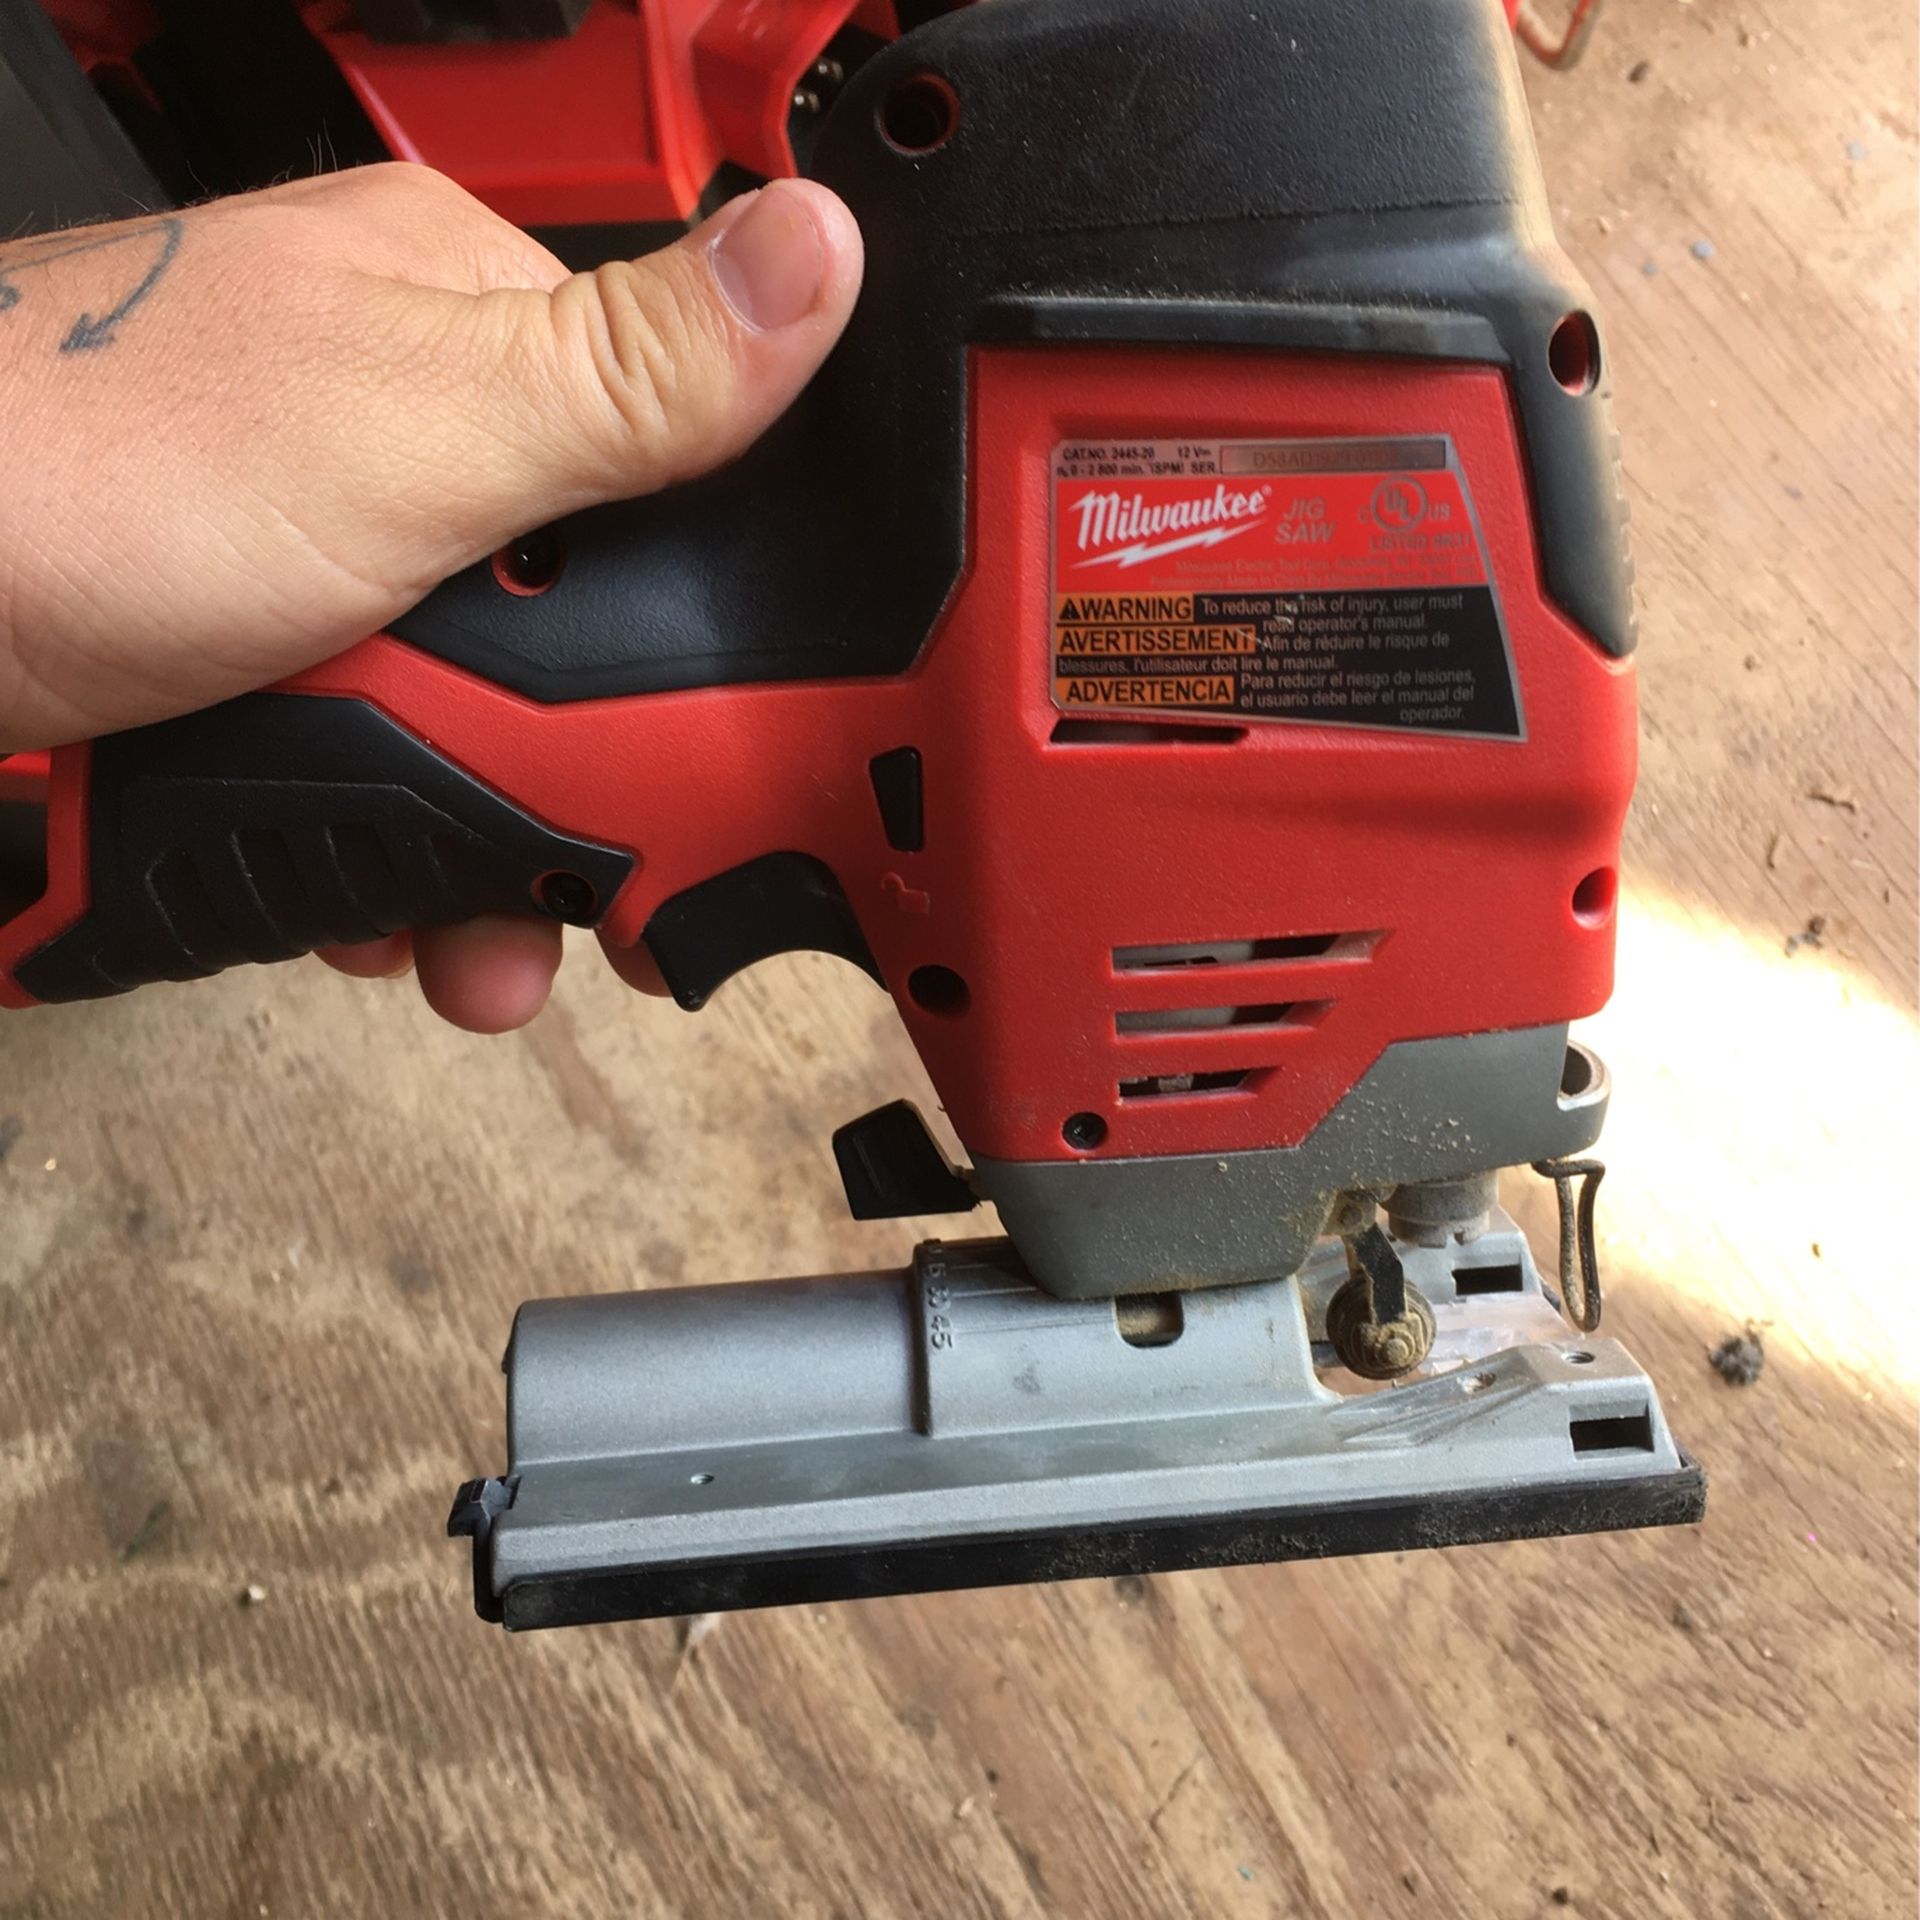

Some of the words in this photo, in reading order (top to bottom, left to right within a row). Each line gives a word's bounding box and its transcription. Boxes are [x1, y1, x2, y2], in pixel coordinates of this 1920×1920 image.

[1178, 446, 1189, 458] 12
[1068, 484, 1267, 552] Milwaukee
[1283, 498, 1327, 522] JIG
[1275, 522, 1337, 545] SAW
[1368, 535, 1428, 551] LISTED
[1080, 597, 1192, 620] WARNING
[1203, 599, 1218, 614] To
[1222, 599, 1271, 615] reduce
[1300, 597, 1327, 612] risk
[1331, 596, 1345, 612] of
[1349, 596, 1390, 615] injury,
[1394, 599, 1424, 611] user
[1429, 594, 1463, 609] must
[1299, 616, 1369, 637] operator's
[1373, 614, 1427, 630] manual.
[1060, 627, 1252, 652] AVERTISSEMENT
[1263, 635, 1290, 651] Afin
[1294, 636, 1311, 651] de
[1315, 634, 1364, 650] réduire
[1369, 634, 1382, 649] le
[1386, 633, 1429, 652] risque
[1433, 632, 1450, 647] de
[1059, 658, 1129, 674] blessures,
[1133, 657, 1207, 672] l'utilisateur
[1211, 657, 1238, 672] doit
[1241, 656, 1263, 671] lire
[1266, 656, 1279, 670] le
[1241, 675, 1273, 689] Para
[1278, 672, 1325, 688] reducir
[1330, 672, 1343, 687] el
[1347, 671, 1390, 690] riesgo
[1393, 669, 1412, 685] de
[1415, 668, 1477, 685] lesiones,
[1066, 680, 1231, 703] ADVERTENCIA
[1240, 693, 1253, 708] el
[1257, 691, 1309, 707] usuario
[1312, 690, 1347, 706] debe
[1351, 689, 1378, 704] leer
[1382, 689, 1395, 704] el
[1400, 687, 1449, 703] manual
[1453, 686, 1475, 701] del
[1400, 705, 1466, 723] operador.
[930, 1315, 954, 1350] 45
